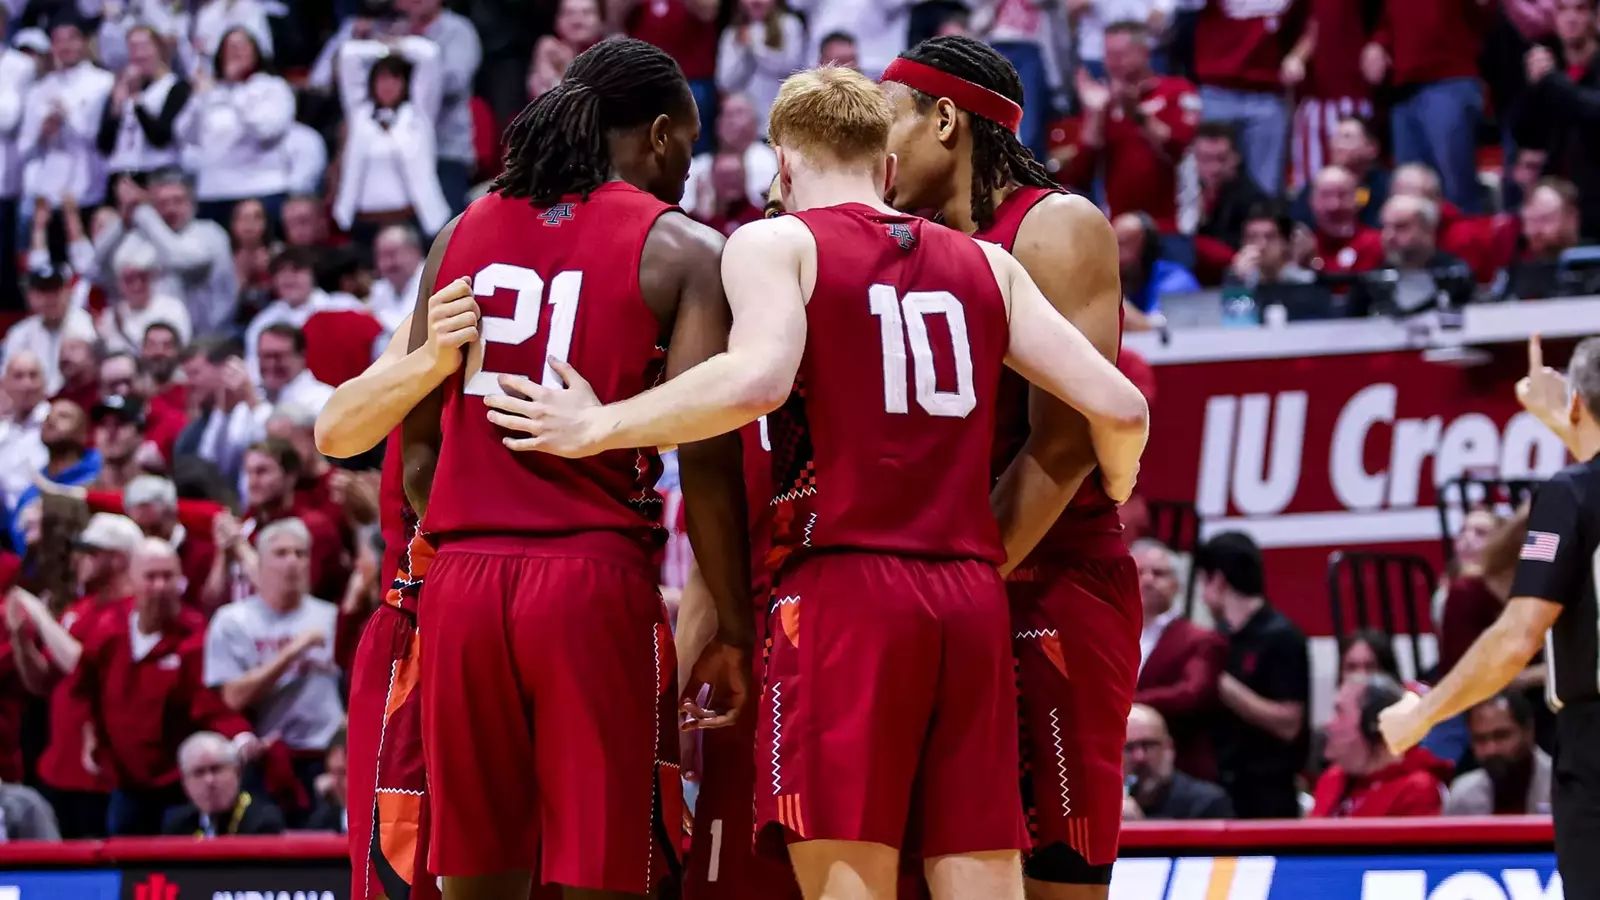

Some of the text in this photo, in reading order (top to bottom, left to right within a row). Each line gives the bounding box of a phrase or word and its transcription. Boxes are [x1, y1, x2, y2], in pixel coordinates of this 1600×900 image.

[464, 263, 583, 396] 21
[869, 284, 977, 419] 10
[1197, 390, 1309, 517] IU
[707, 819, 723, 882] 1
